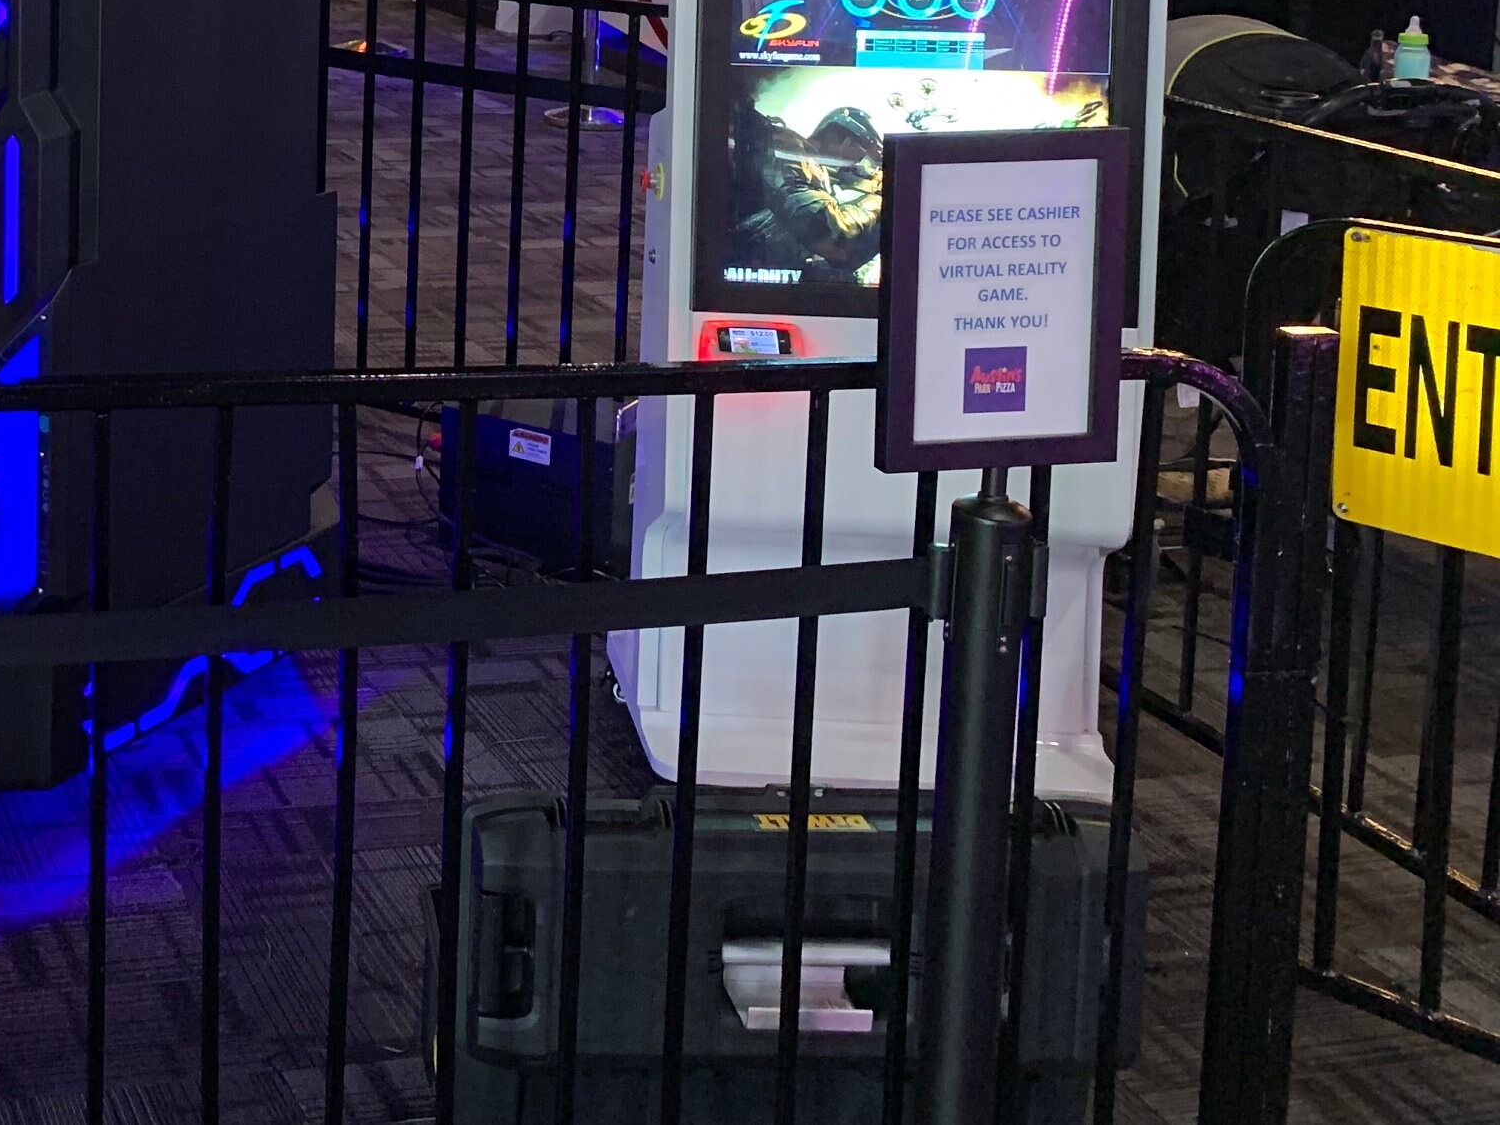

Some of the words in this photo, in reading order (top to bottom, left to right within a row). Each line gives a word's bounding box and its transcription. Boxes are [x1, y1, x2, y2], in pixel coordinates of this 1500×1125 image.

[768, 39, 820, 47] SKYFUN
[929, 208, 983, 223] PLEASE
[987, 208, 1013, 222] SEE
[1017, 206, 1080, 221] CASHIER
[947, 237, 977, 251] FOR
[981, 235, 1036, 249] ACCESS
[1041, 234, 1061, 247] TO
[939, 263, 1003, 279] VIRTUAL
[1007, 262, 1067, 277] REALITY
[978, 288, 1028, 302] GAME.
[954, 316, 1006, 331] THANK
[1010, 314, 1049, 329] YOU!
